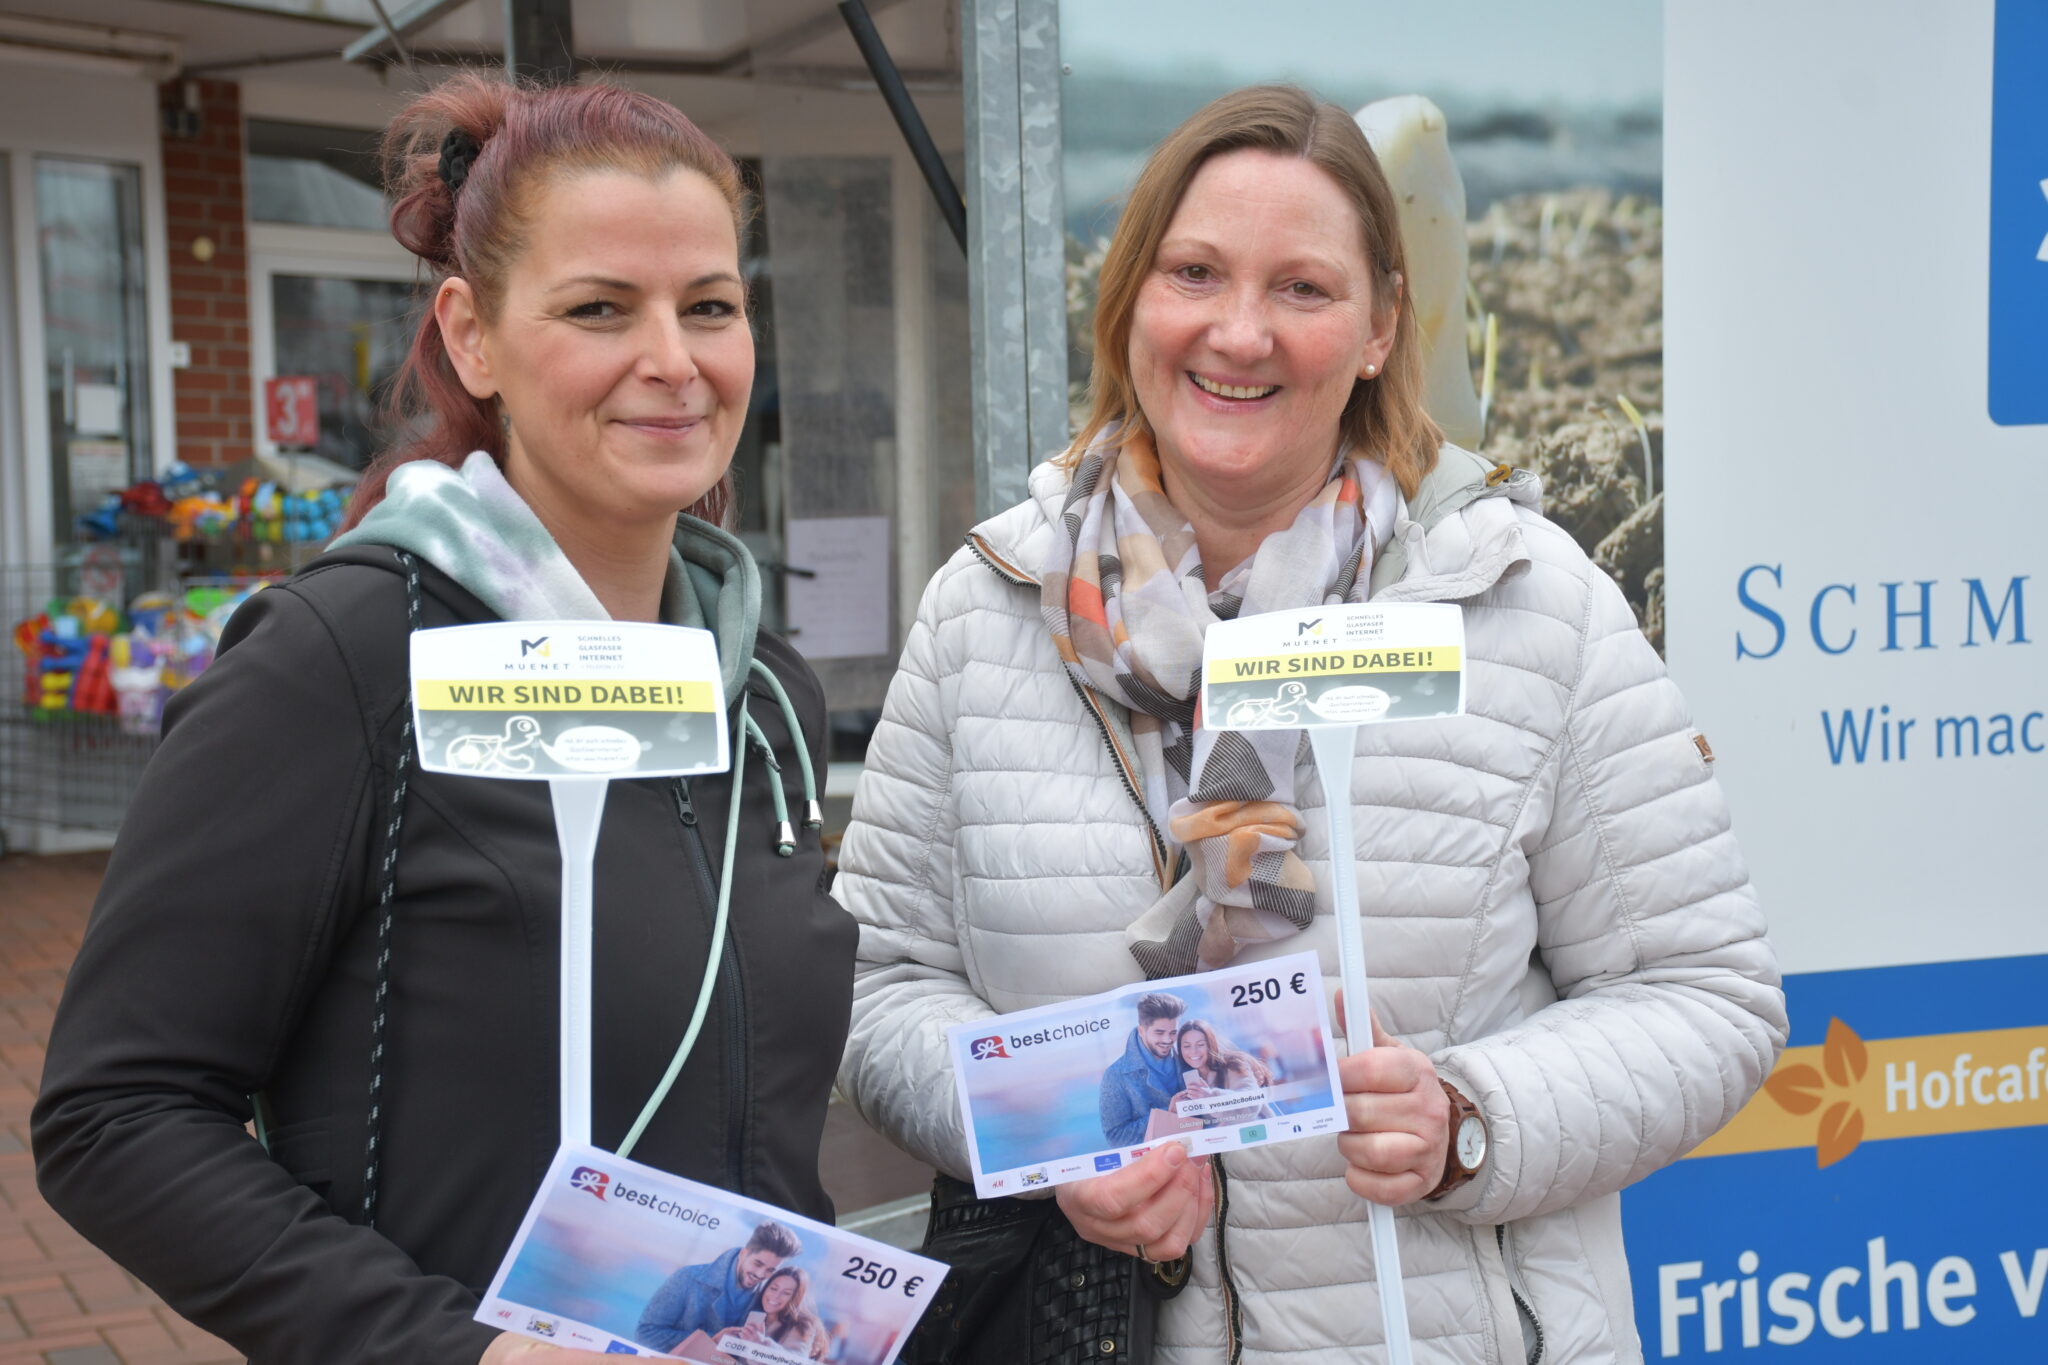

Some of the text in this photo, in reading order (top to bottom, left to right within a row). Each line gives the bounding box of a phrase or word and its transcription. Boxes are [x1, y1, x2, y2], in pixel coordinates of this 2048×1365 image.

[1283, 638, 1338, 647] MUENET
[1235, 651, 1433, 677] WIR SIND DABEI!
[449, 685, 685, 704] WIR SIND DABEI!
[1821, 705, 2045, 766] Wir mac
[1230, 972, 1307, 1008] 250 €
[1009, 1016, 1112, 1050] bestchoice
[1886, 1047, 2048, 1113] Hofcaf
[613, 1182, 721, 1231] bestchoice
[842, 1256, 925, 1298] 250 €
[1658, 1236, 1977, 1358] Frische
